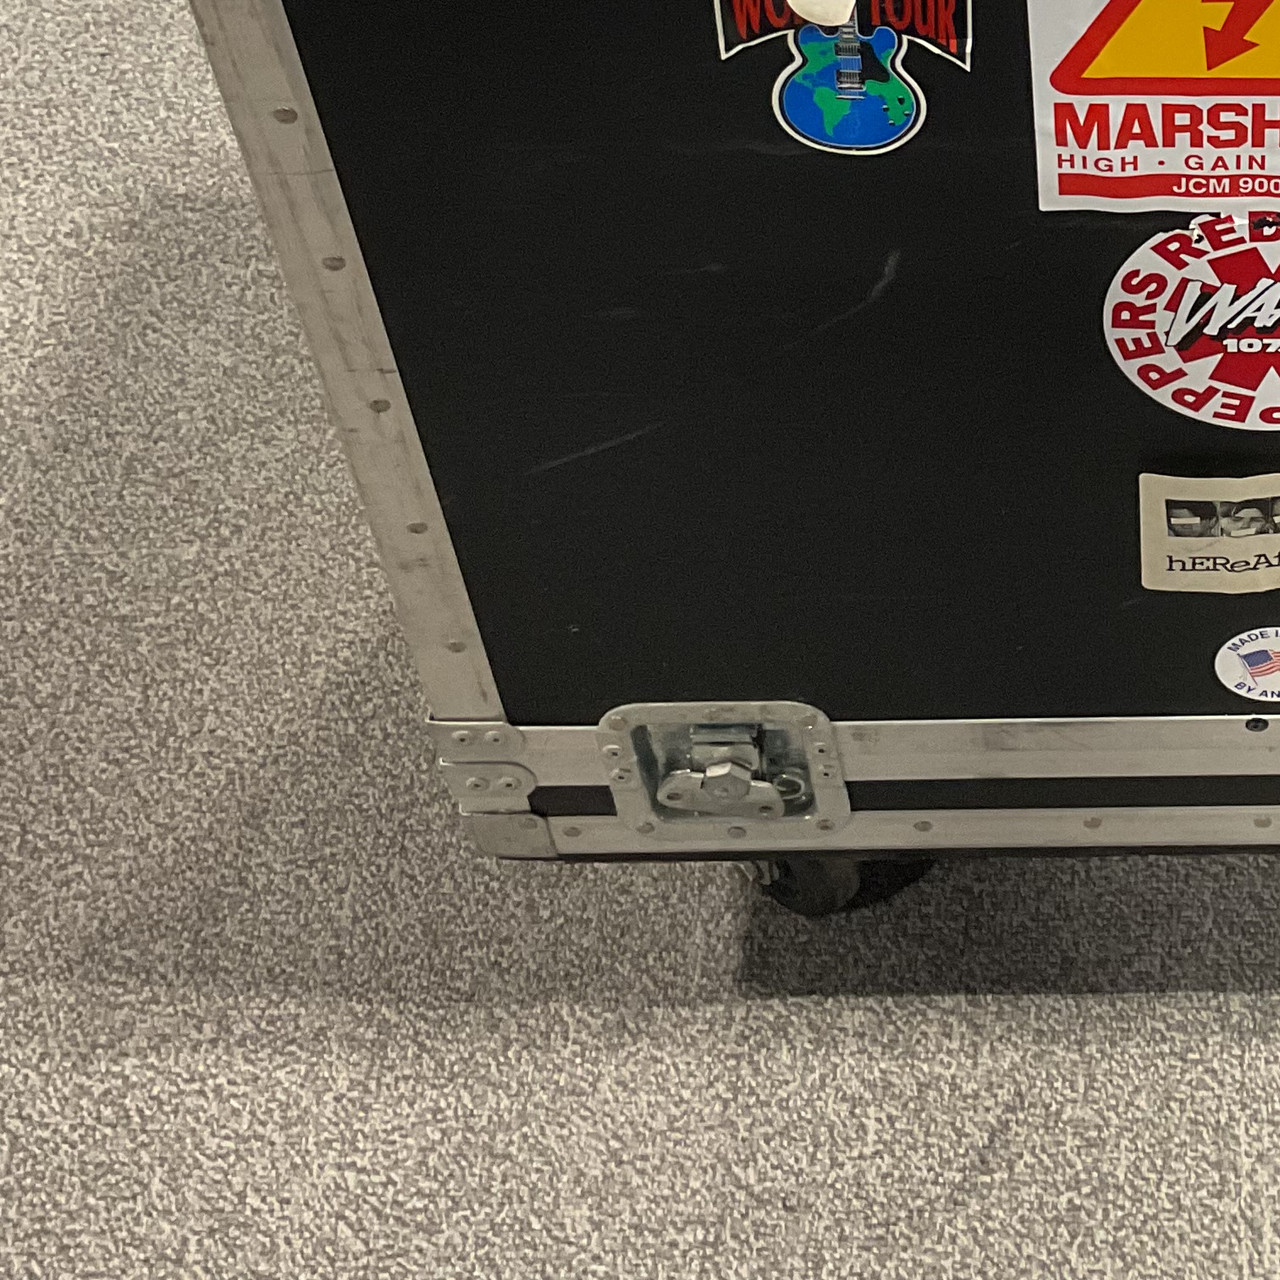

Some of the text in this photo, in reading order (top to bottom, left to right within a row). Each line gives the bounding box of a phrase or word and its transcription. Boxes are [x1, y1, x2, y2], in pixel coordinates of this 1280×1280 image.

[1057, 153, 1139, 173] HIGH
[1184, 154, 1267, 172] GAIN
[1172, 177, 1230, 194] JCM
[1226, 629, 1271, 653] MADE
[1234, 681, 1256, 694] BY
